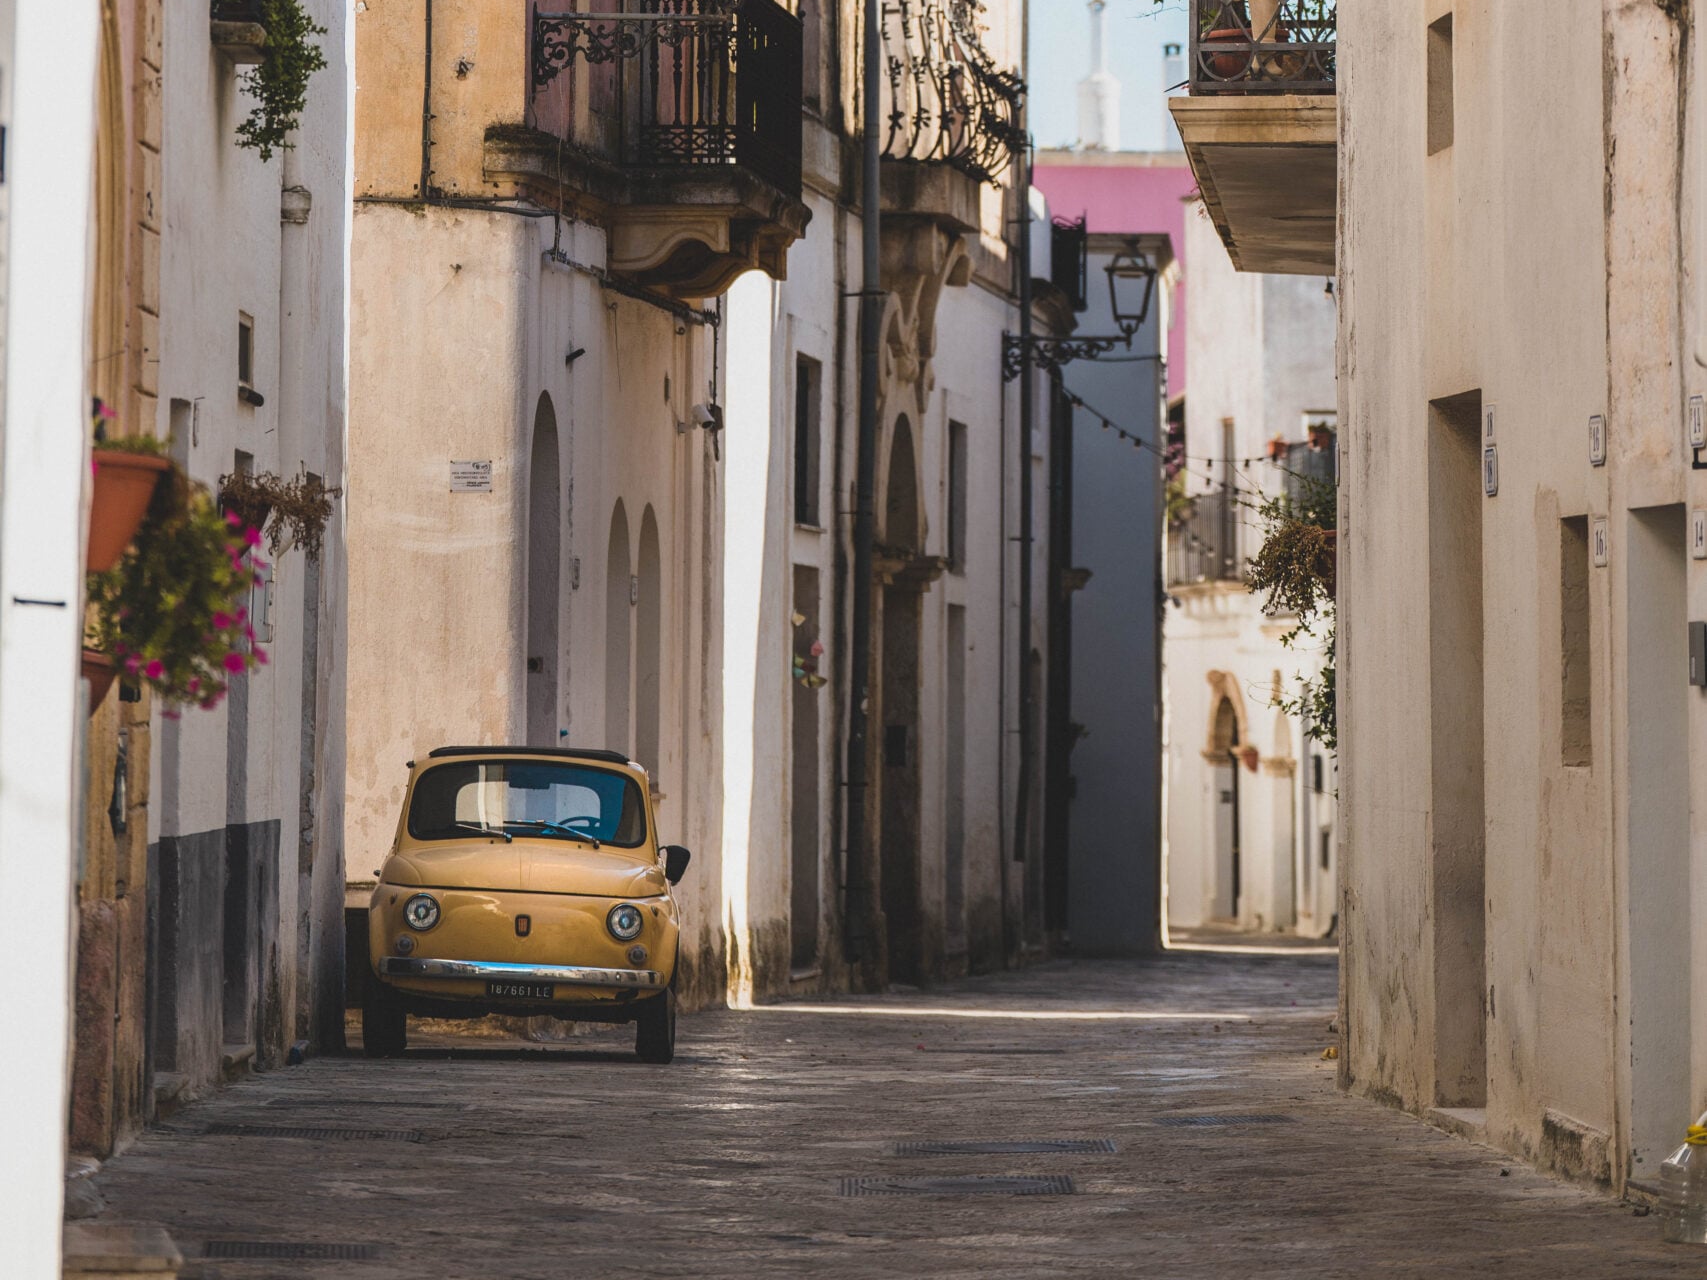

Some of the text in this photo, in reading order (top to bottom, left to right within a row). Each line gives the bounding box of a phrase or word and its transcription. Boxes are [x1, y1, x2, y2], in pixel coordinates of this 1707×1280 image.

[1486, 411, 1493, 437] 18
[1693, 407, 1701, 434] 14
[1592, 425, 1600, 452] 16
[1595, 529, 1604, 556] 16
[1695, 519, 1703, 548] 14
[491, 983, 550, 997] 187661 LE
